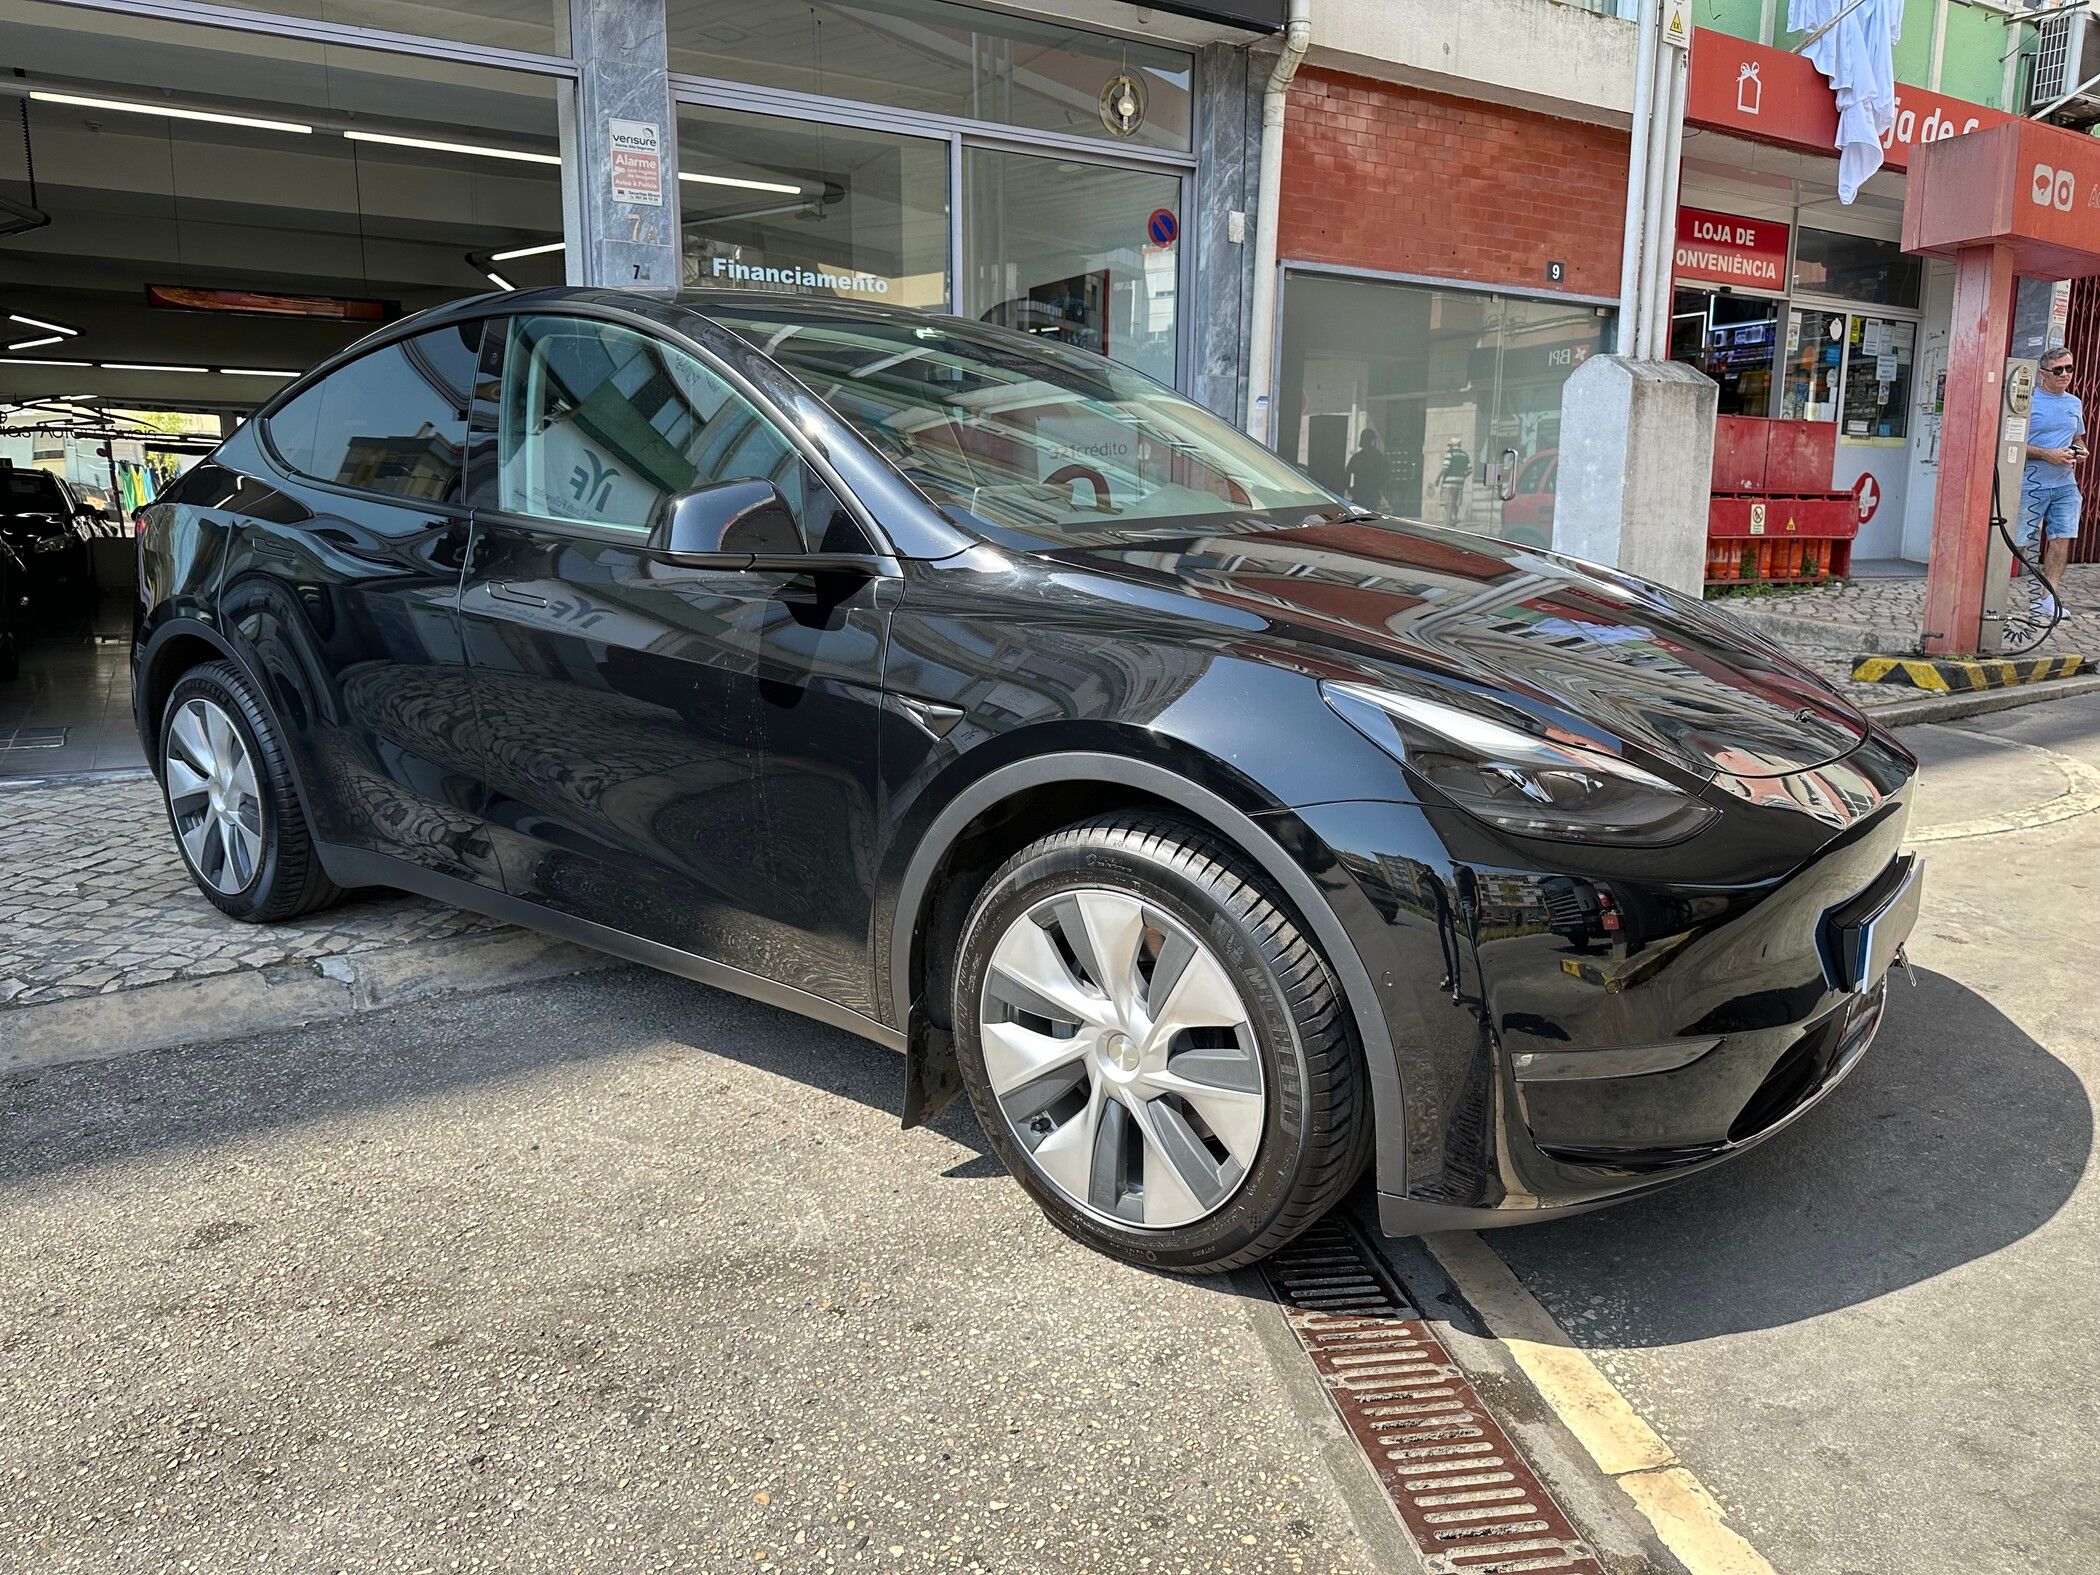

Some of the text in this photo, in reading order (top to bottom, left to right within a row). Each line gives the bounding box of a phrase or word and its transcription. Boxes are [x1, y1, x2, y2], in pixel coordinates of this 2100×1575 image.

[1883, 96, 1955, 149] ja de
[612, 134, 657, 147] verisure
[616, 154, 657, 169] Alarme
[1694, 220, 1756, 247] LOJA DE
[633, 264, 640, 279] 7
[1552, 264, 1561, 280] 9
[1675, 248, 1777, 280] ONVENIÊNCIA
[712, 257, 889, 294] Financiamento
